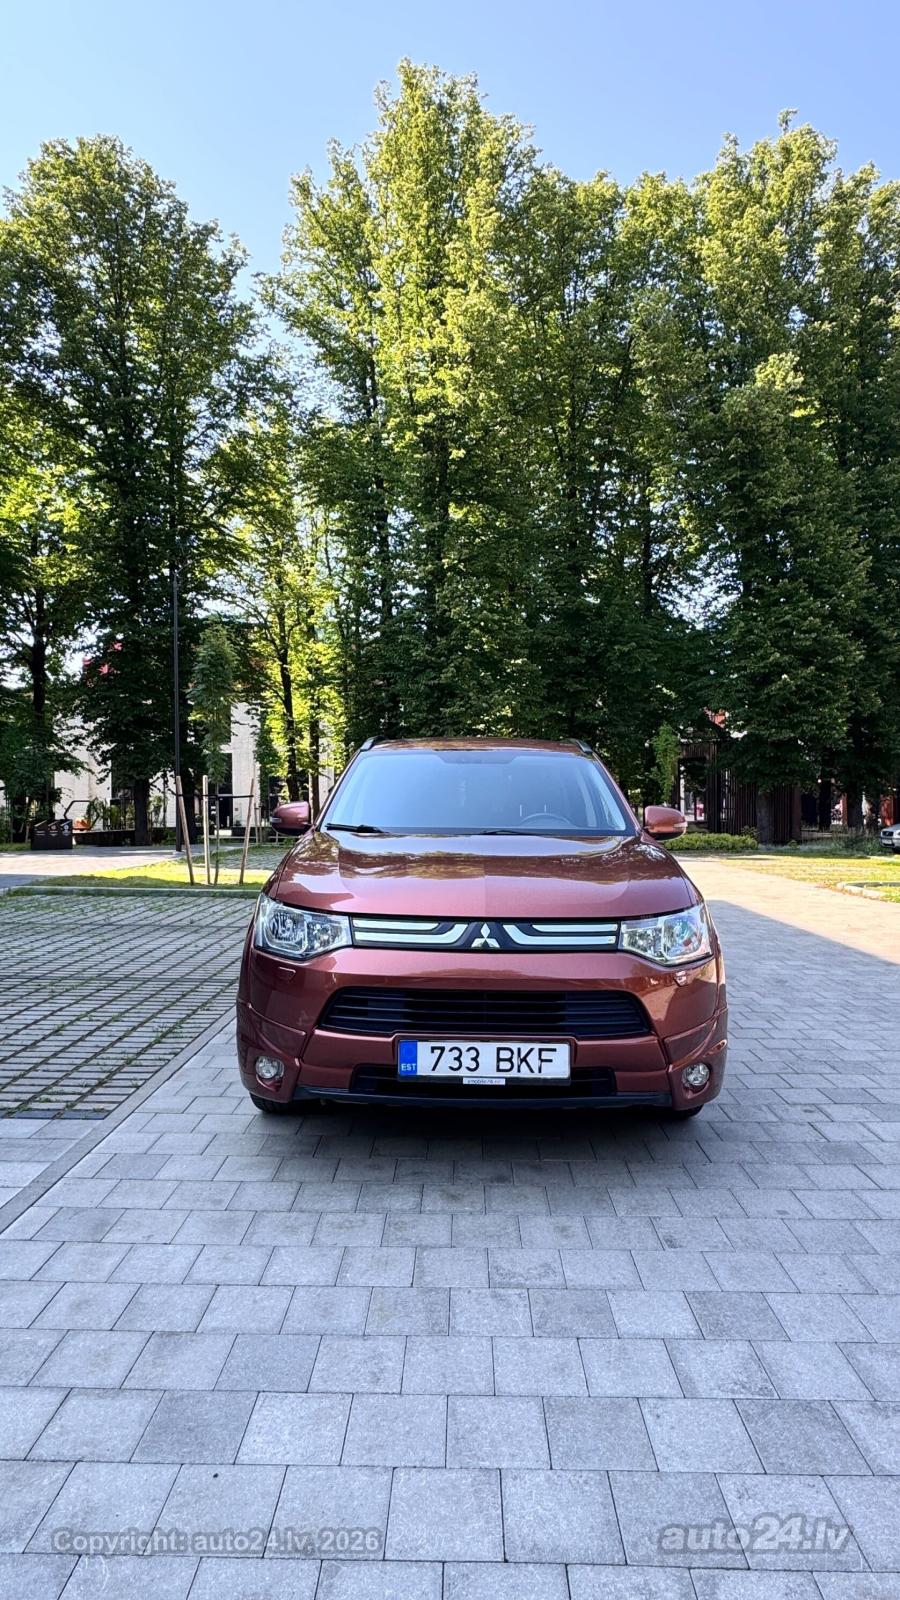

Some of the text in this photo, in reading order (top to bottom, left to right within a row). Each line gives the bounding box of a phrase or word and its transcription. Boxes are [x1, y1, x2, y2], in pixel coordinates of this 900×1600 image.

[401, 1063, 417, 1072] EST
[430, 1045, 557, 1074] 733 BKF
